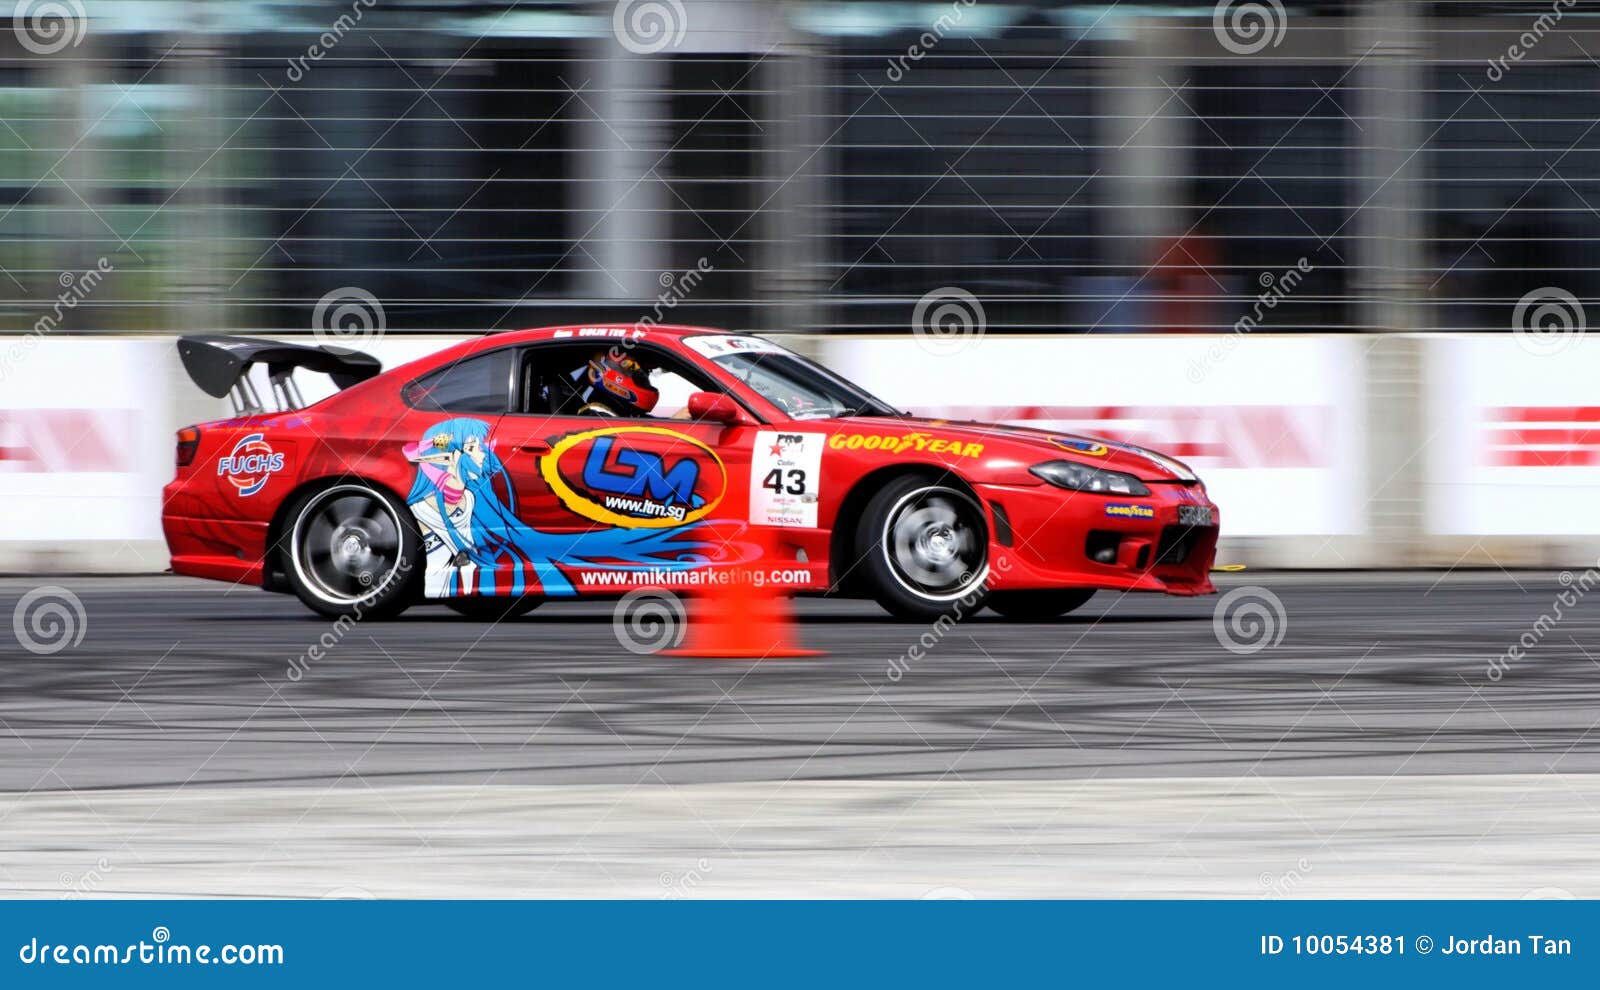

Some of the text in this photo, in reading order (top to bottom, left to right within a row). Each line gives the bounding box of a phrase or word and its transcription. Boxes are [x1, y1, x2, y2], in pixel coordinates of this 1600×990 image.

[829, 432, 984, 458] GOODYEAR
[217, 452, 285, 476] FUCHS
[763, 468, 806, 495] 43
[605, 496, 686, 521] www.ltm.sg
[768, 516, 803, 524] NISSAN
[581, 567, 811, 587] www.mikimarketing.com
